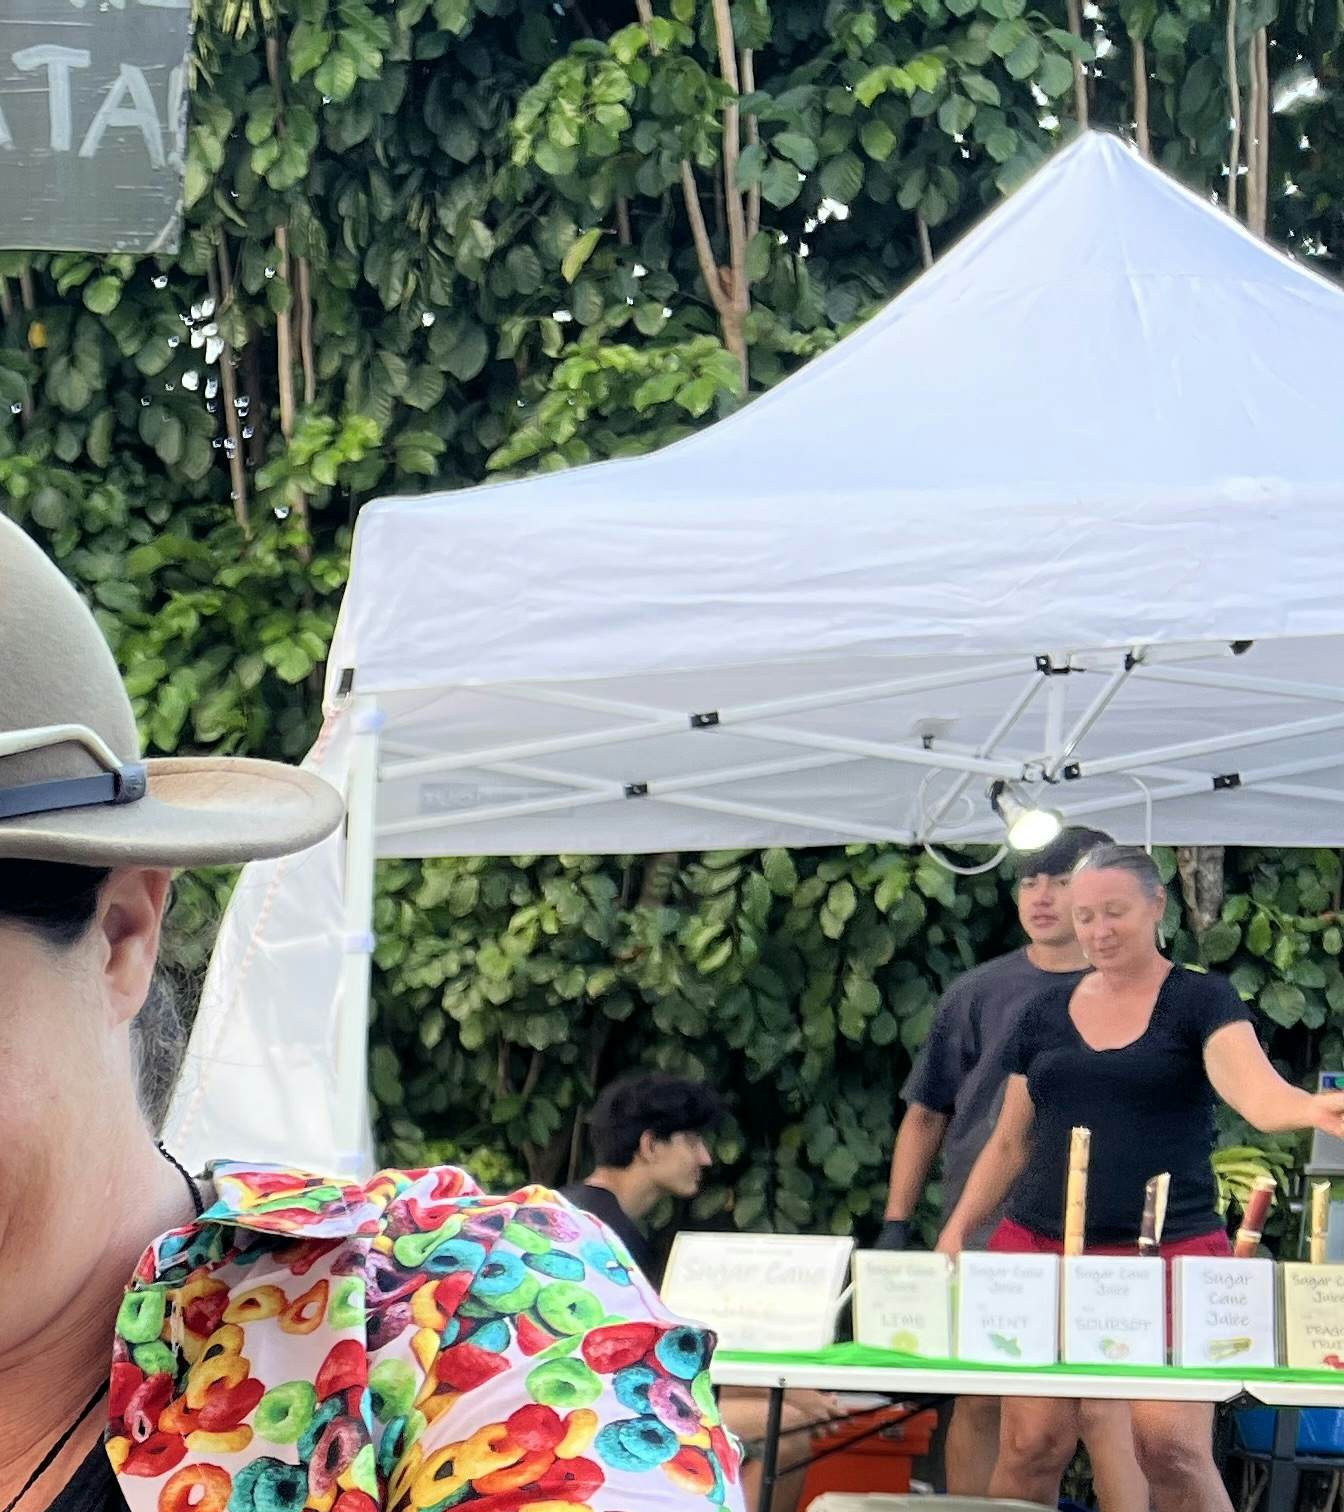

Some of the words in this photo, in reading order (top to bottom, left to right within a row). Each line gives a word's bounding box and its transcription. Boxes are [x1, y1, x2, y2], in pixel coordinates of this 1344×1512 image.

[683, 1256, 759, 1288] Sugar
[1201, 1269, 1252, 1290] Sugar
[1292, 1273, 1332, 1290] Sugar
[1209, 1290, 1249, 1306] Cane
[881, 1313, 924, 1329] LIME
[1205, 1311, 1249, 1327] Juice
